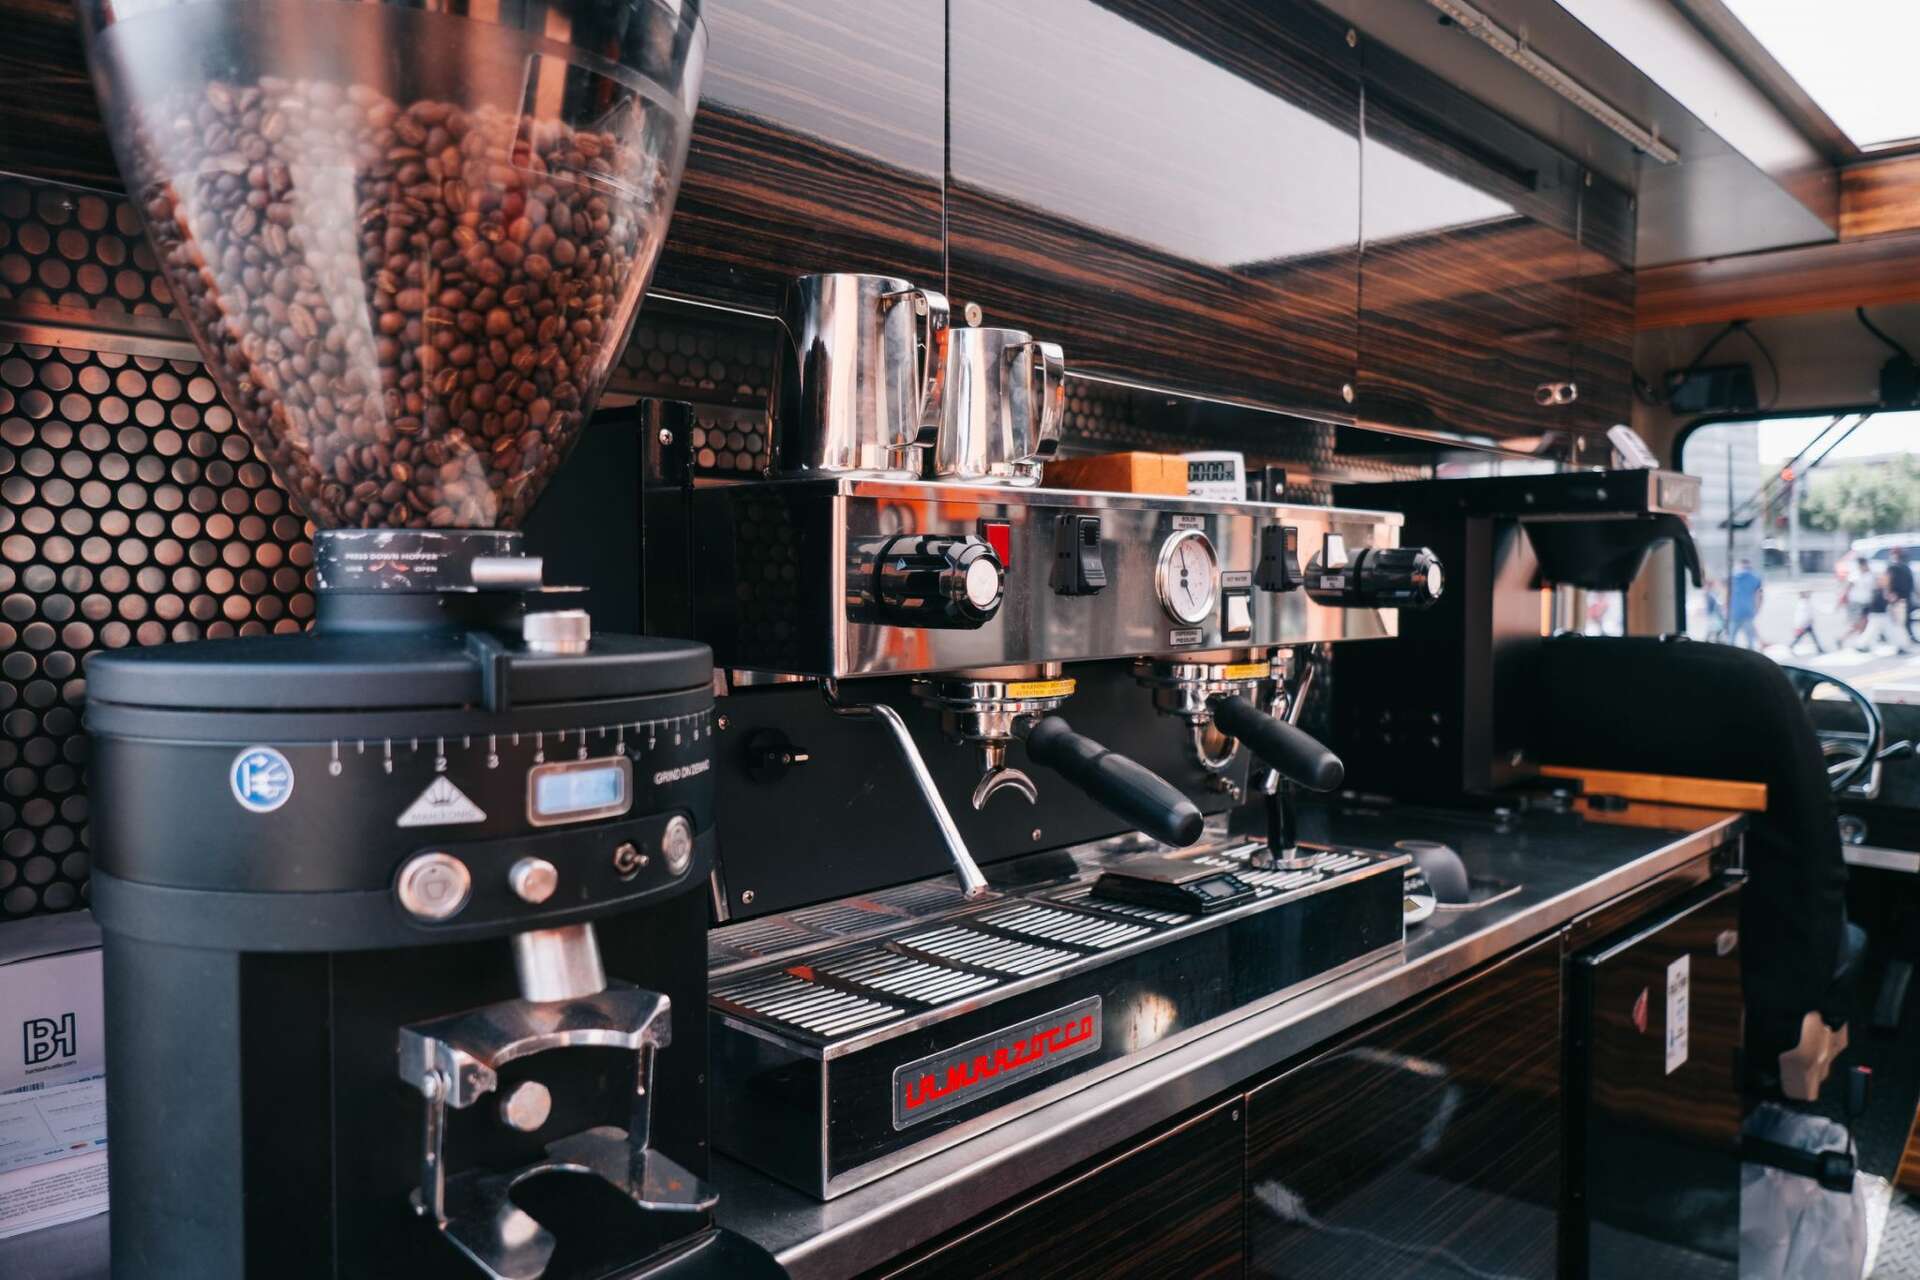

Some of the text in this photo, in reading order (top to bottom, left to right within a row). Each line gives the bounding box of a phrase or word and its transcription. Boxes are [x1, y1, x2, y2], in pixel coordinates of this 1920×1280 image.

[368, 552, 400, 561] DOWN
[383, 758, 393, 775] 1
[435, 755, 448, 772] 2
[487, 753, 500, 770] 3
[534, 751, 545, 763] 4
[578, 746, 588, 760] 5
[616, 742, 626, 756] 6
[649, 738, 656, 750] 7
